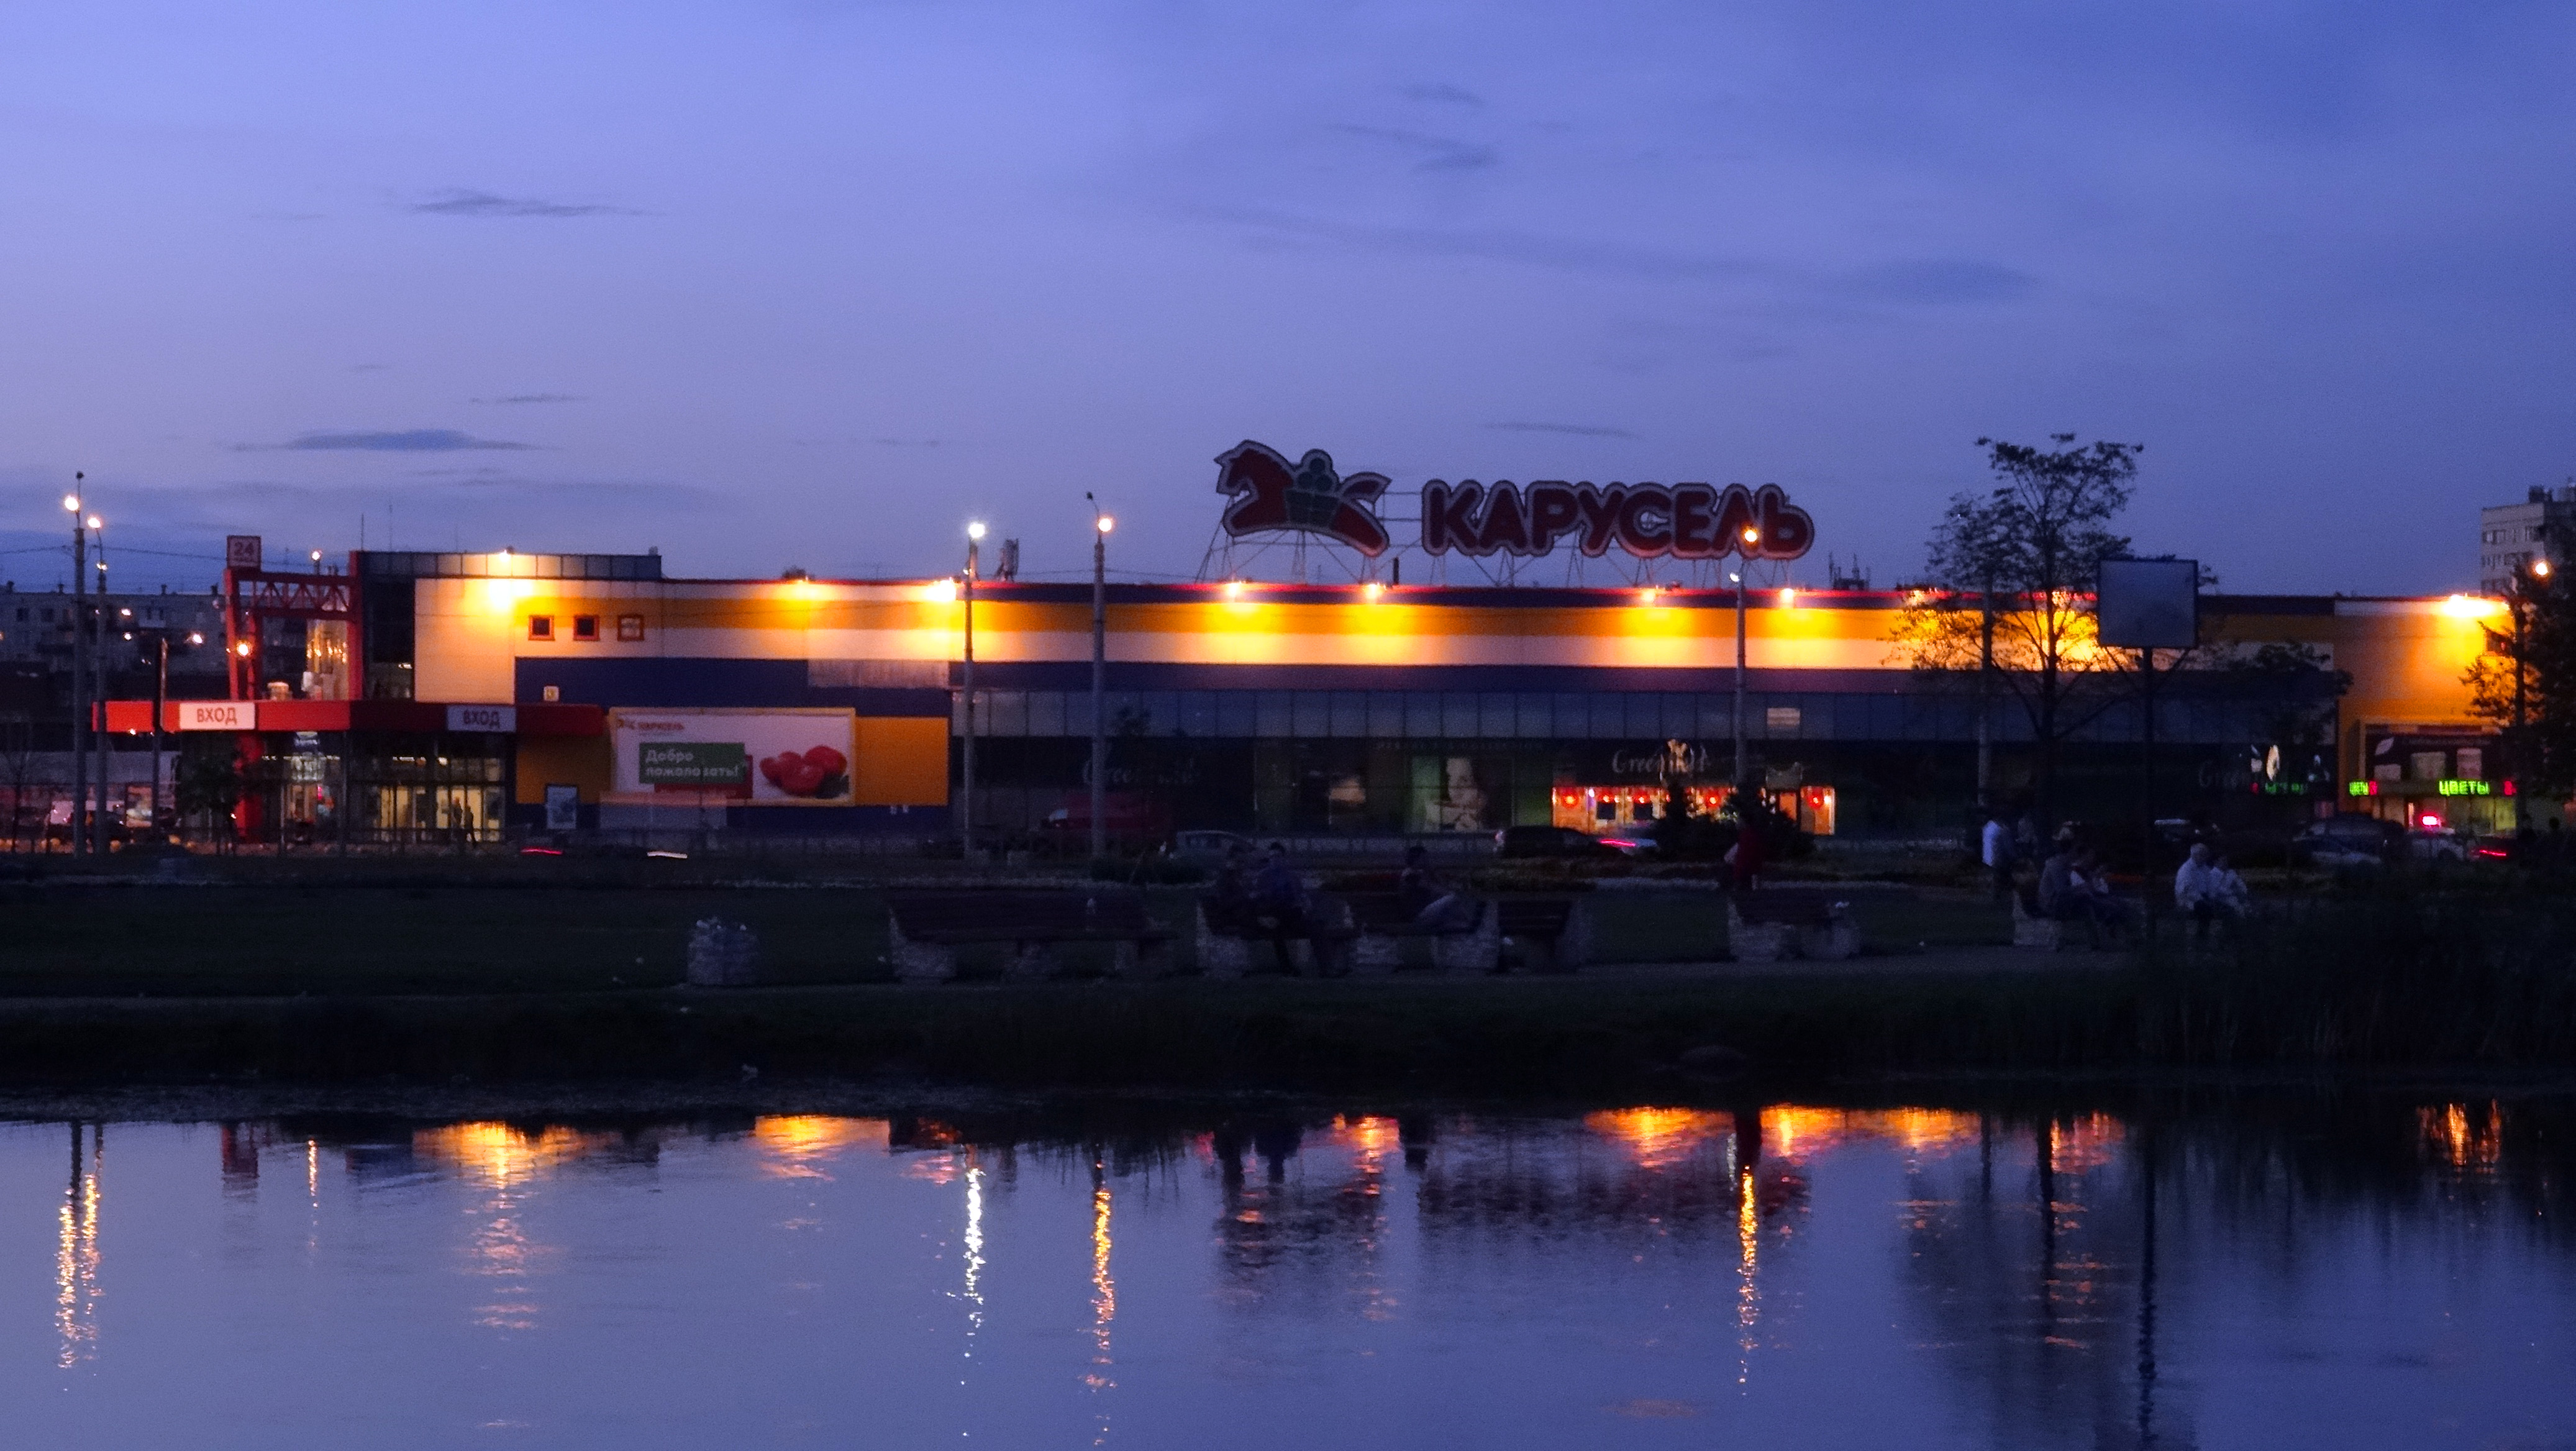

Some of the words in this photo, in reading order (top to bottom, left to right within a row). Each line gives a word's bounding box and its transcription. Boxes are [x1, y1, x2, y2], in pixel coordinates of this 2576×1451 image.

[1422, 480, 1814, 559] КАРУСЕЛЬ
[234, 542, 255, 557] 24
[196, 707, 237, 725] ВХОД
[463, 711, 501, 728] ВХОД
[645, 749, 694, 763] Добро
[2439, 780, 2490, 796] ЦВЕТЫ
